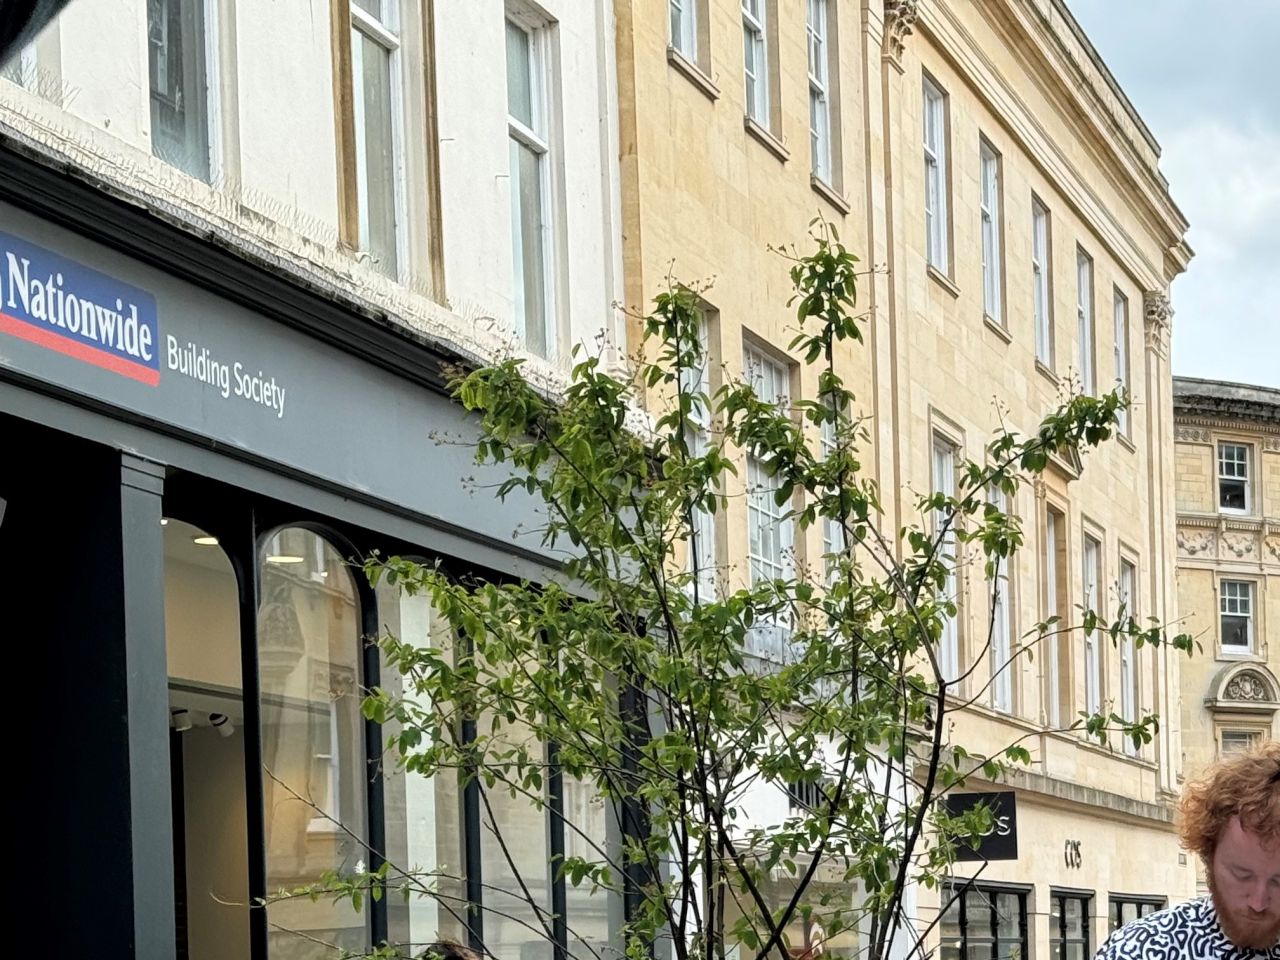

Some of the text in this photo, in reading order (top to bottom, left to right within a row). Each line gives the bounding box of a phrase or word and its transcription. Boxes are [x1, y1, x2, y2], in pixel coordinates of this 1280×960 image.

[6, 251, 153, 362] Nationwide
[166, 333, 286, 419] Building Society
